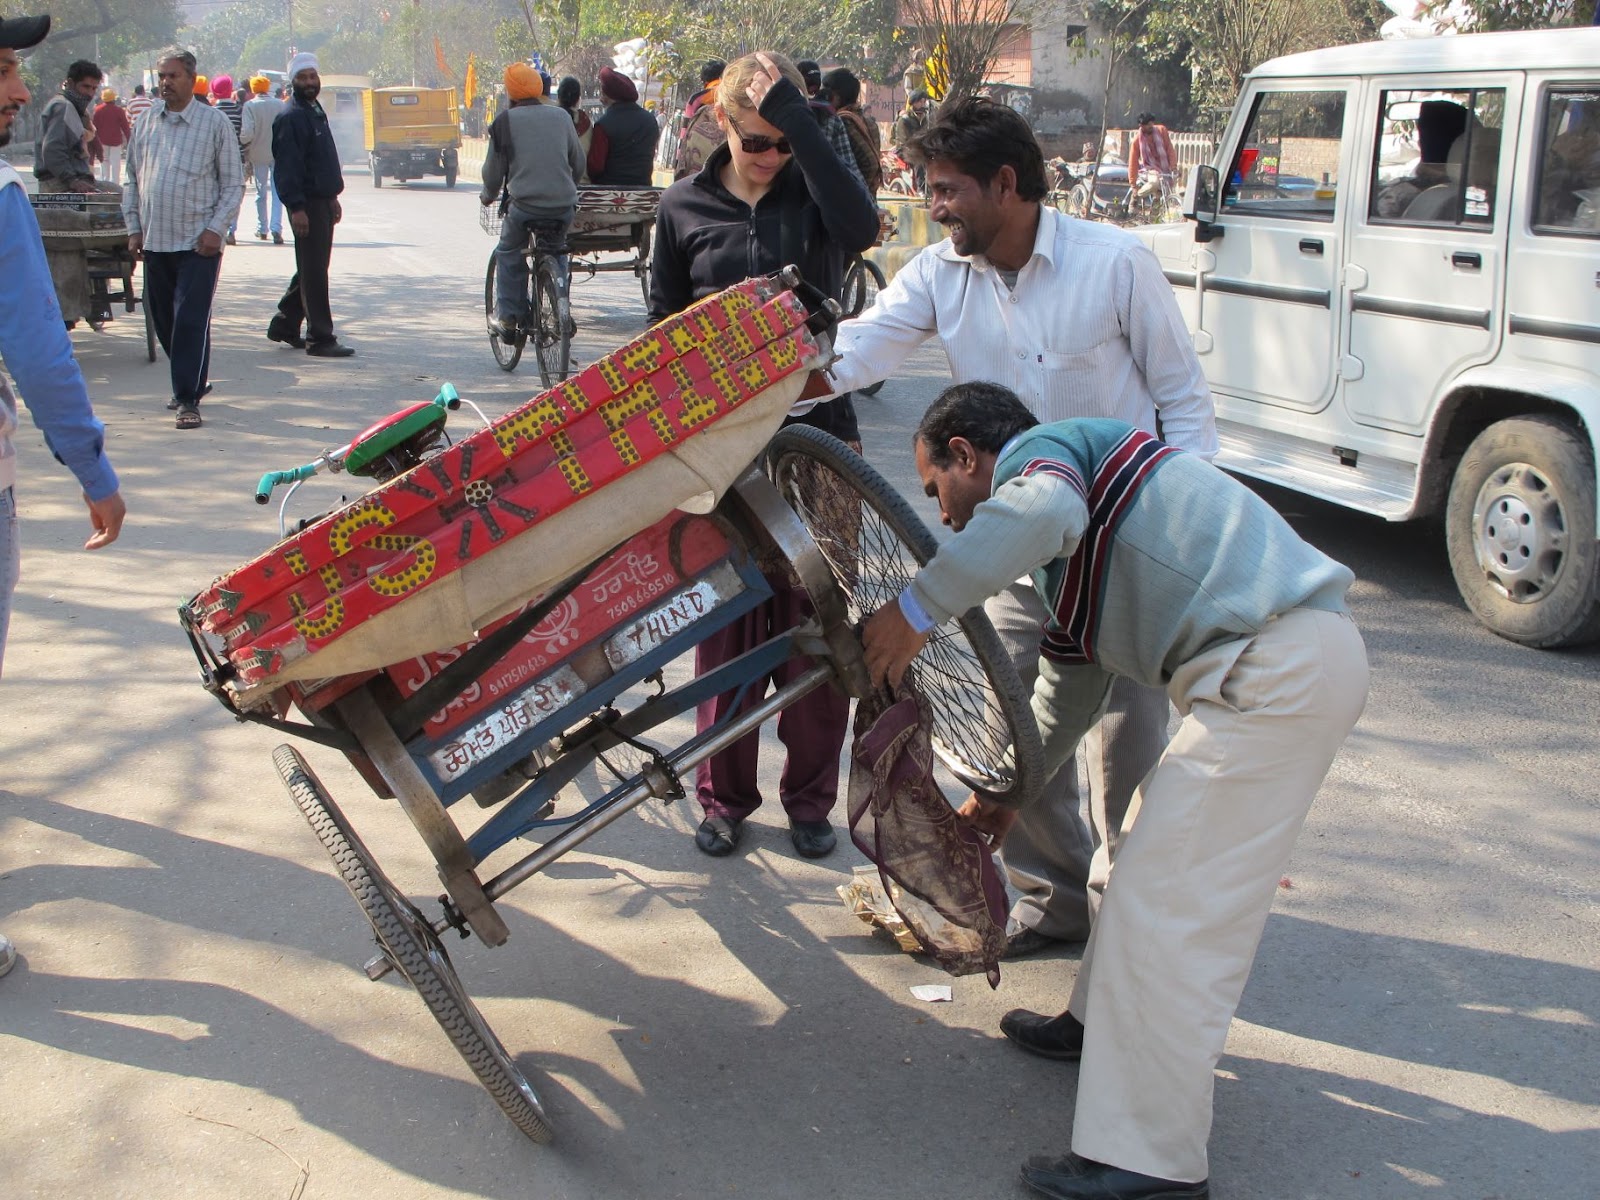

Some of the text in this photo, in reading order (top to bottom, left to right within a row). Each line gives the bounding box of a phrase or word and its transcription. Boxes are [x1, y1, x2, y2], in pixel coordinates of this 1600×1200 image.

[491, 290, 798, 494] THIND
[606, 573, 675, 620] 7508669510
[627, 591, 703, 651] THIND
